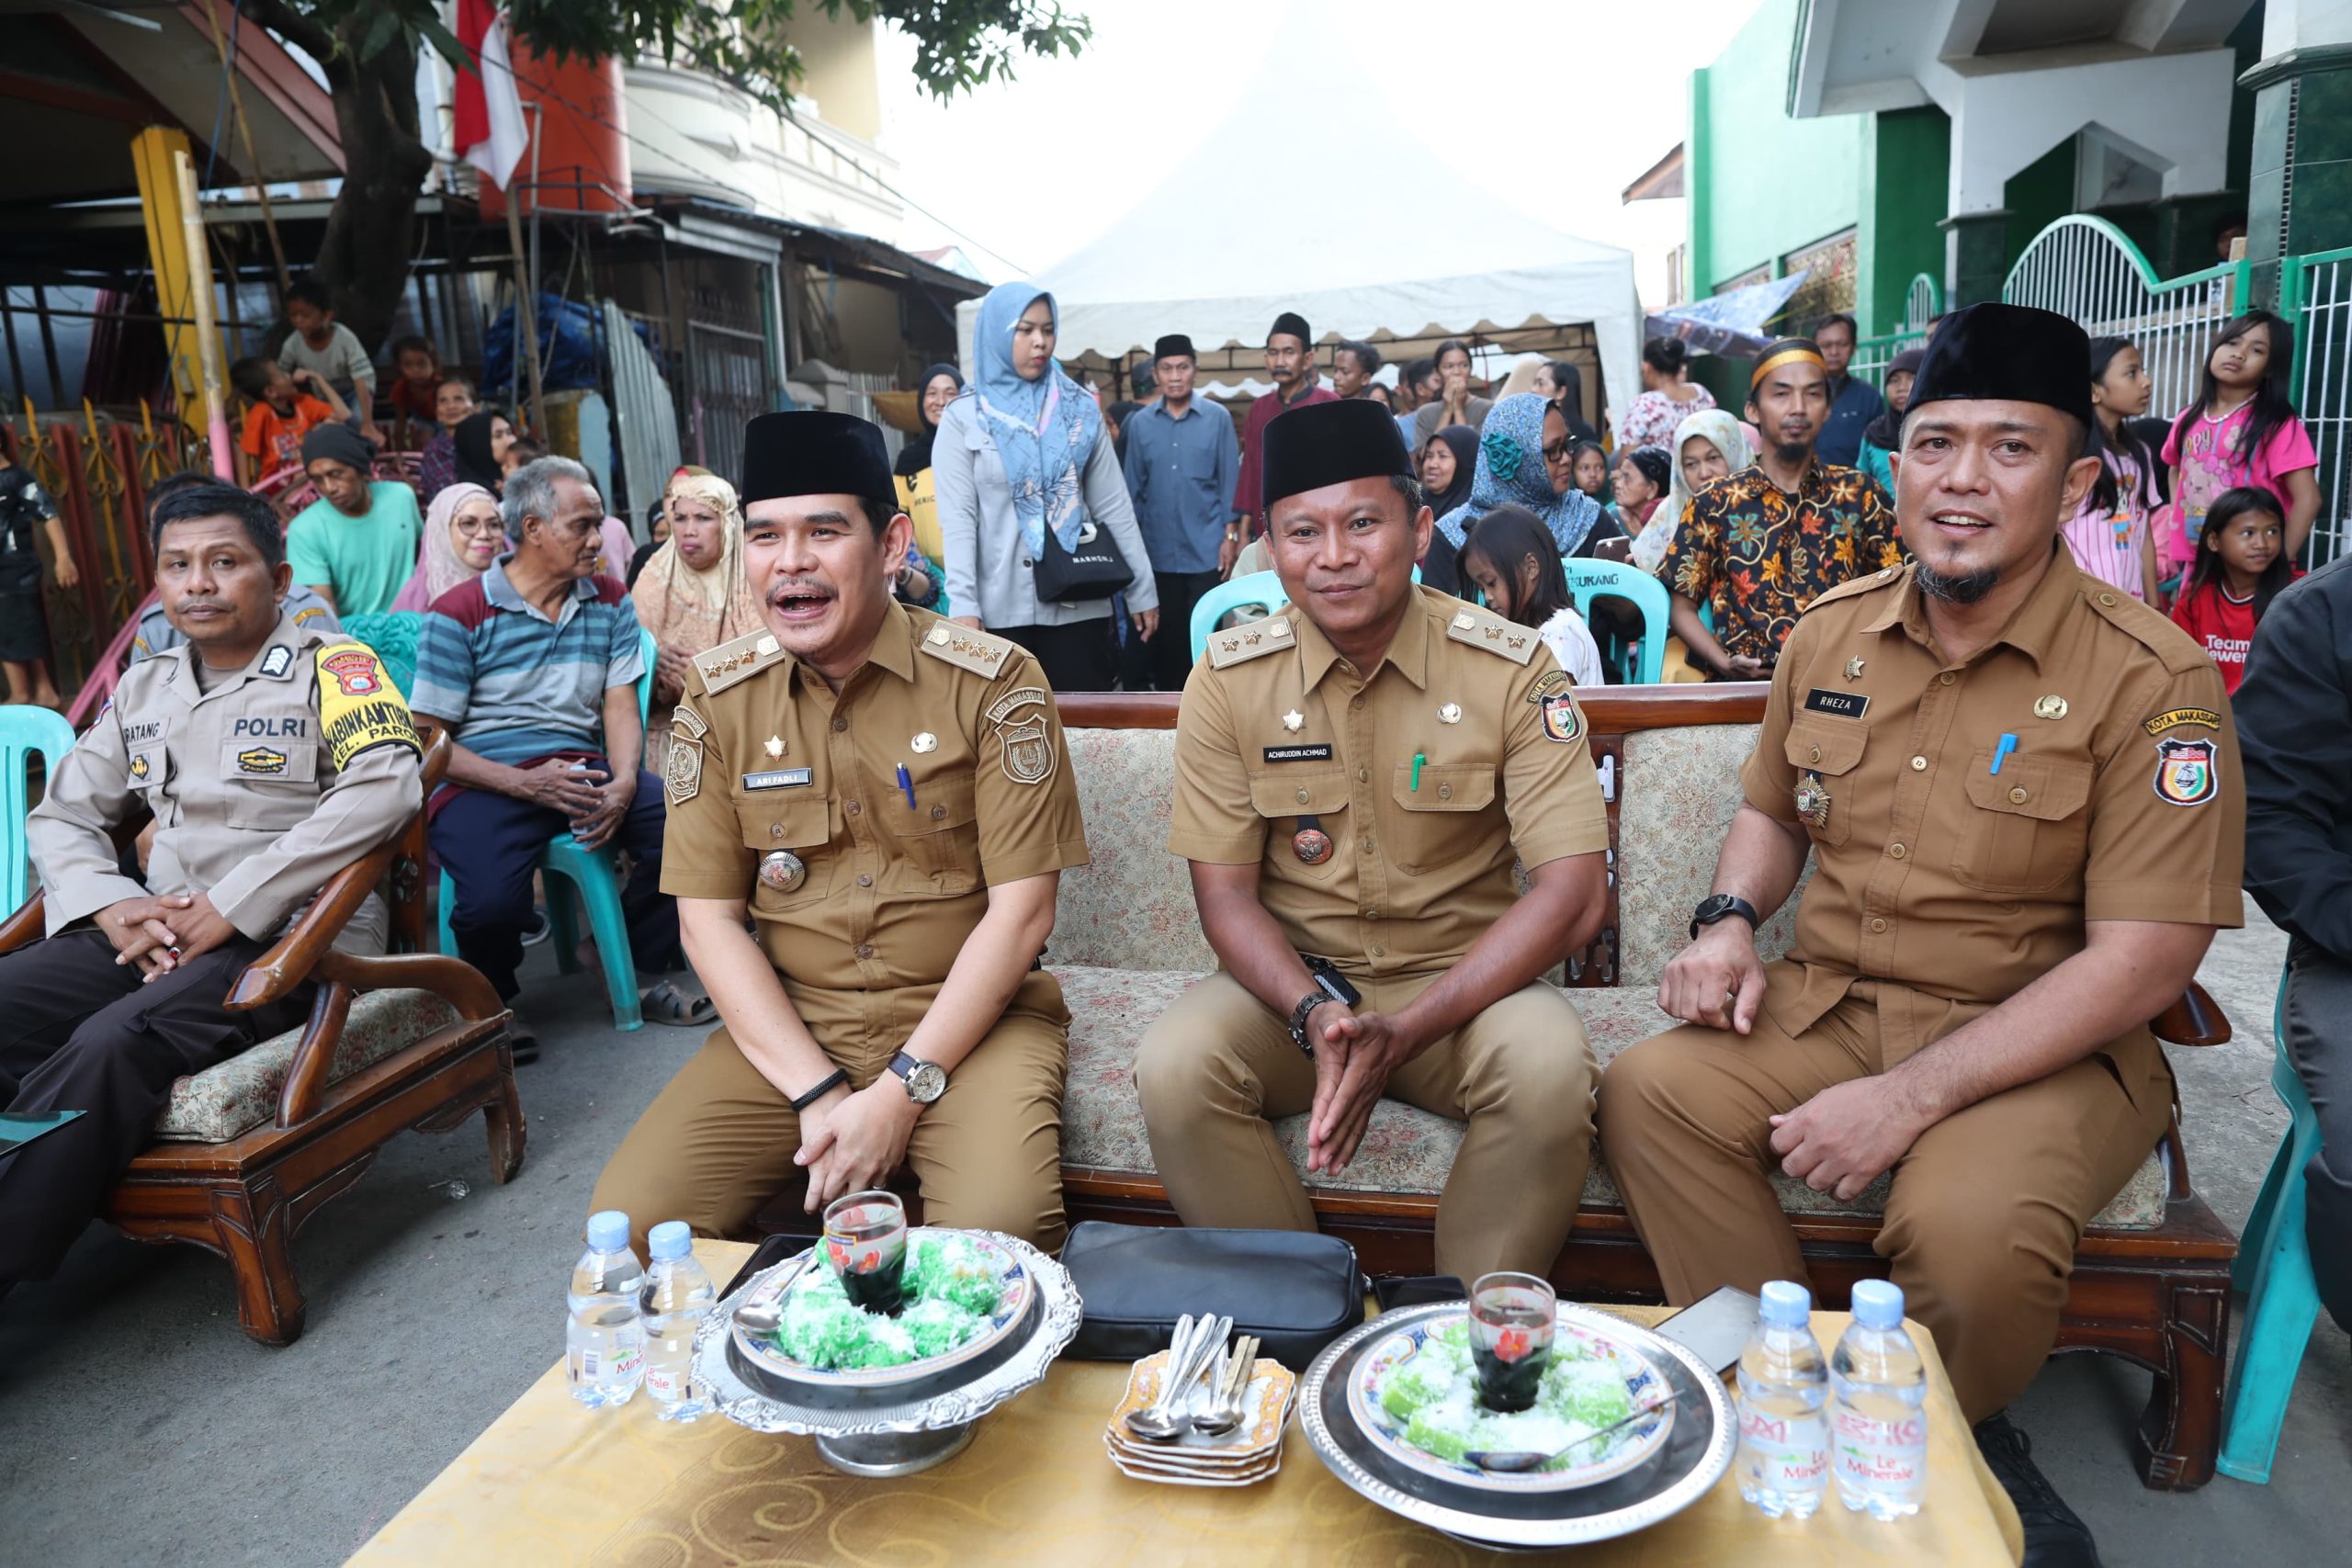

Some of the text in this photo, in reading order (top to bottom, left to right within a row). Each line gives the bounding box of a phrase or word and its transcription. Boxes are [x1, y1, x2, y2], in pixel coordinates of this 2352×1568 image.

[2206, 634, 2251, 651] Team
[992, 701, 1010, 717] KOTA
[1820, 696, 1851, 710] RHEZA
[233, 717, 306, 738] POLRI
[2147, 714, 2175, 732] KOTA
[1268, 748, 1328, 759] ACHIRUDDIN ACHMAD
[773, 773, 797, 784] FADLI
[1847, 1458, 1915, 1481] Minerale
[1877, 1454, 1896, 1470] Le
